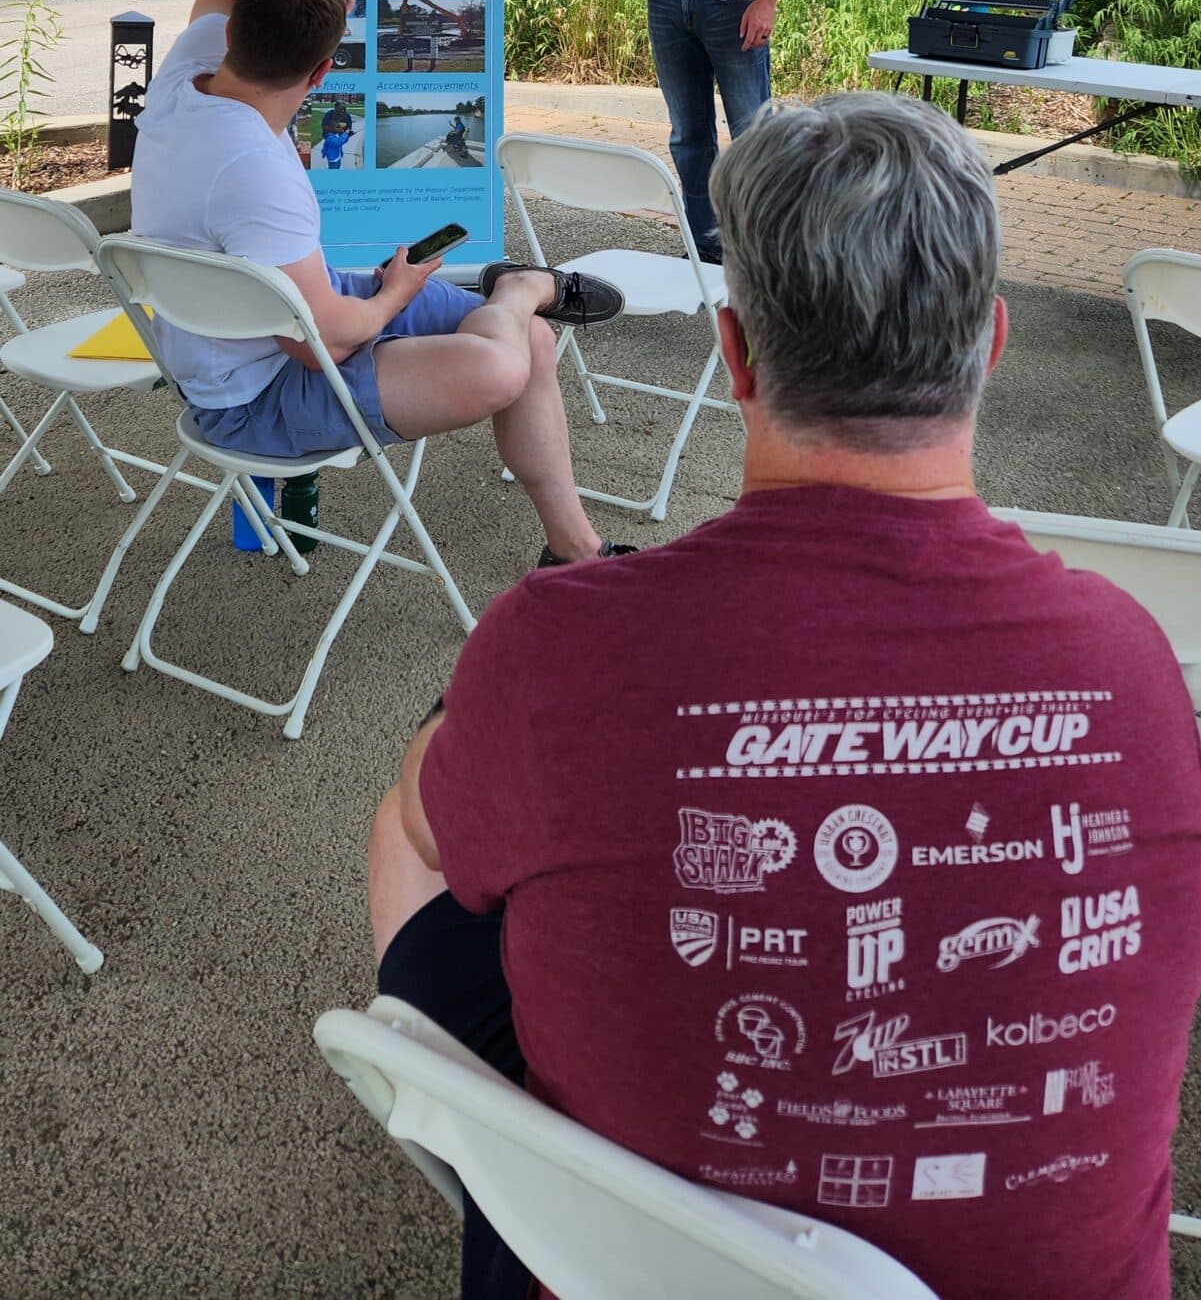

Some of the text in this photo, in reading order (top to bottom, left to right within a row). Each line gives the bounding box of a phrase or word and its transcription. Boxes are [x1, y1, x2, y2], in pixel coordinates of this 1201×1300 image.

[323, 81, 356, 92] fishing
[377, 81, 479, 92] Access improvements
[740, 708, 837, 725] MISSOURI'S
[846, 707, 876, 722] TOP
[883, 705, 949, 721] CYCLING
[725, 712, 1090, 766] GATEWAY CUP
[688, 812, 753, 850] BIG
[820, 808, 894, 846] URBAN CHESTNUT
[1081, 810, 1122, 829] HEATHER
[1088, 824, 1130, 845] JOHNSON
[681, 846, 767, 884] SHARK
[911, 838, 1044, 867] EMERSON
[674, 911, 713, 927] USA
[845, 897, 903, 927] POWER
[1084, 884, 1140, 930] USA
[739, 926, 808, 954] PRT
[1058, 920, 1143, 975] CRITS
[846, 928, 905, 990] UP
[845, 979, 906, 1002] CYCLING
[986, 1003, 1118, 1047] kolbeco
[878, 1057, 900, 1074] IN
[900, 1040, 952, 1071] STL
[937, 1084, 1017, 1101] LAFAYETTE
[948, 1098, 1004, 1112] SQUARE
[776, 1098, 908, 1119] FIELDS FOODS
